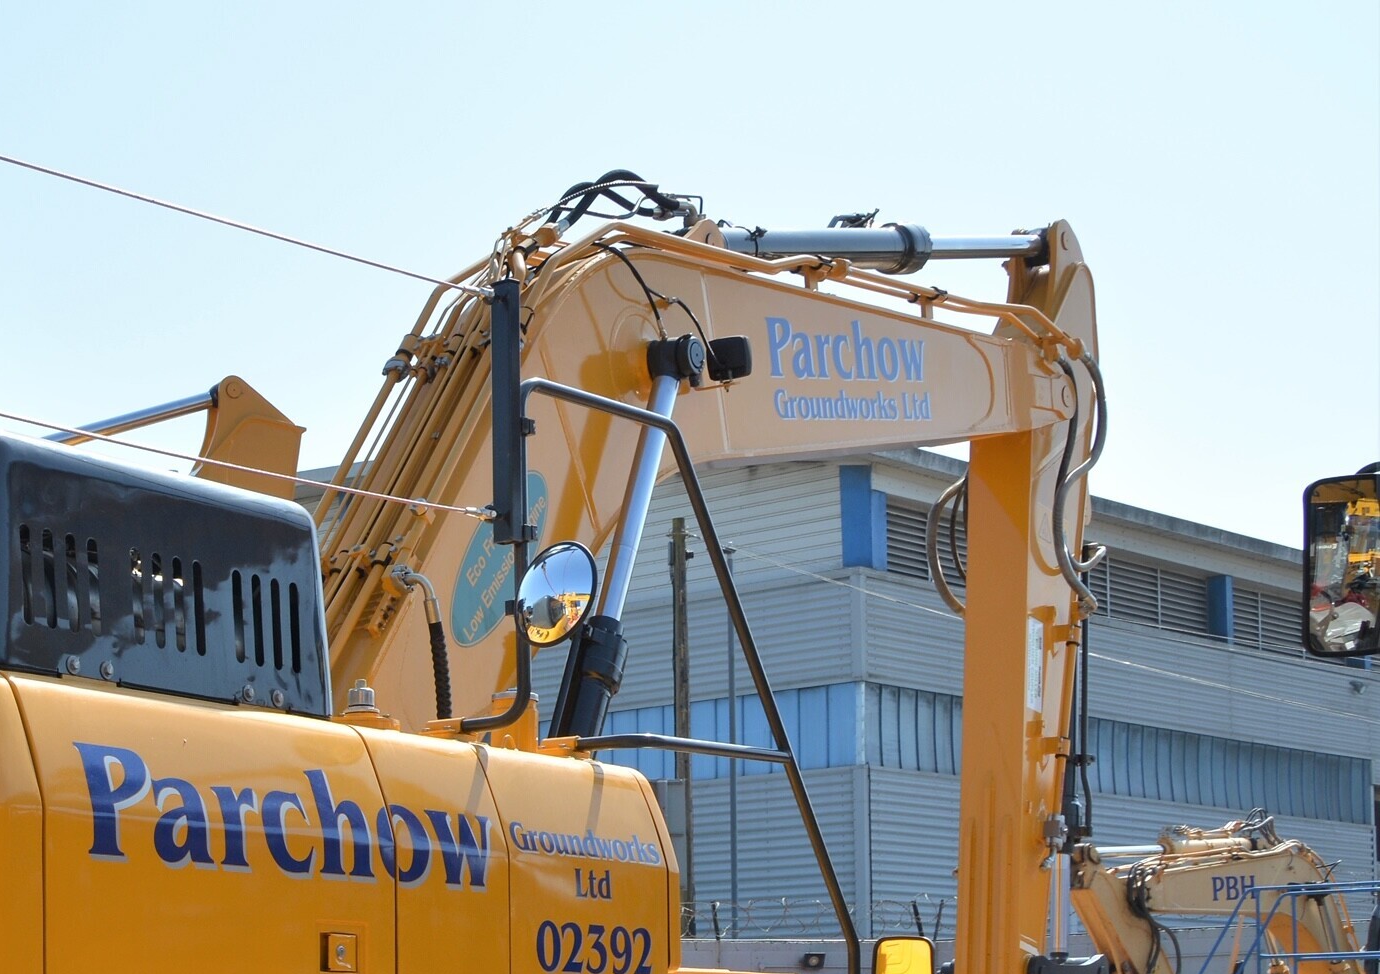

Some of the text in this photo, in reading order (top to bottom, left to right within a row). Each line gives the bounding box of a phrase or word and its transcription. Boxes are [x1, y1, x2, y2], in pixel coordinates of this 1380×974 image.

[765, 317, 924, 382] Parchow
[774, 388, 932, 422] Groundworks Ltd
[466, 556, 486, 587] Eco
[463, 606, 485, 641] Low
[481, 551, 515, 609] Emissio
[72, 741, 492, 892] Parchow
[509, 821, 661, 866] Groundworks
[574, 868, 614, 900] Ltd
[1211, 875, 1257, 901] PBH
